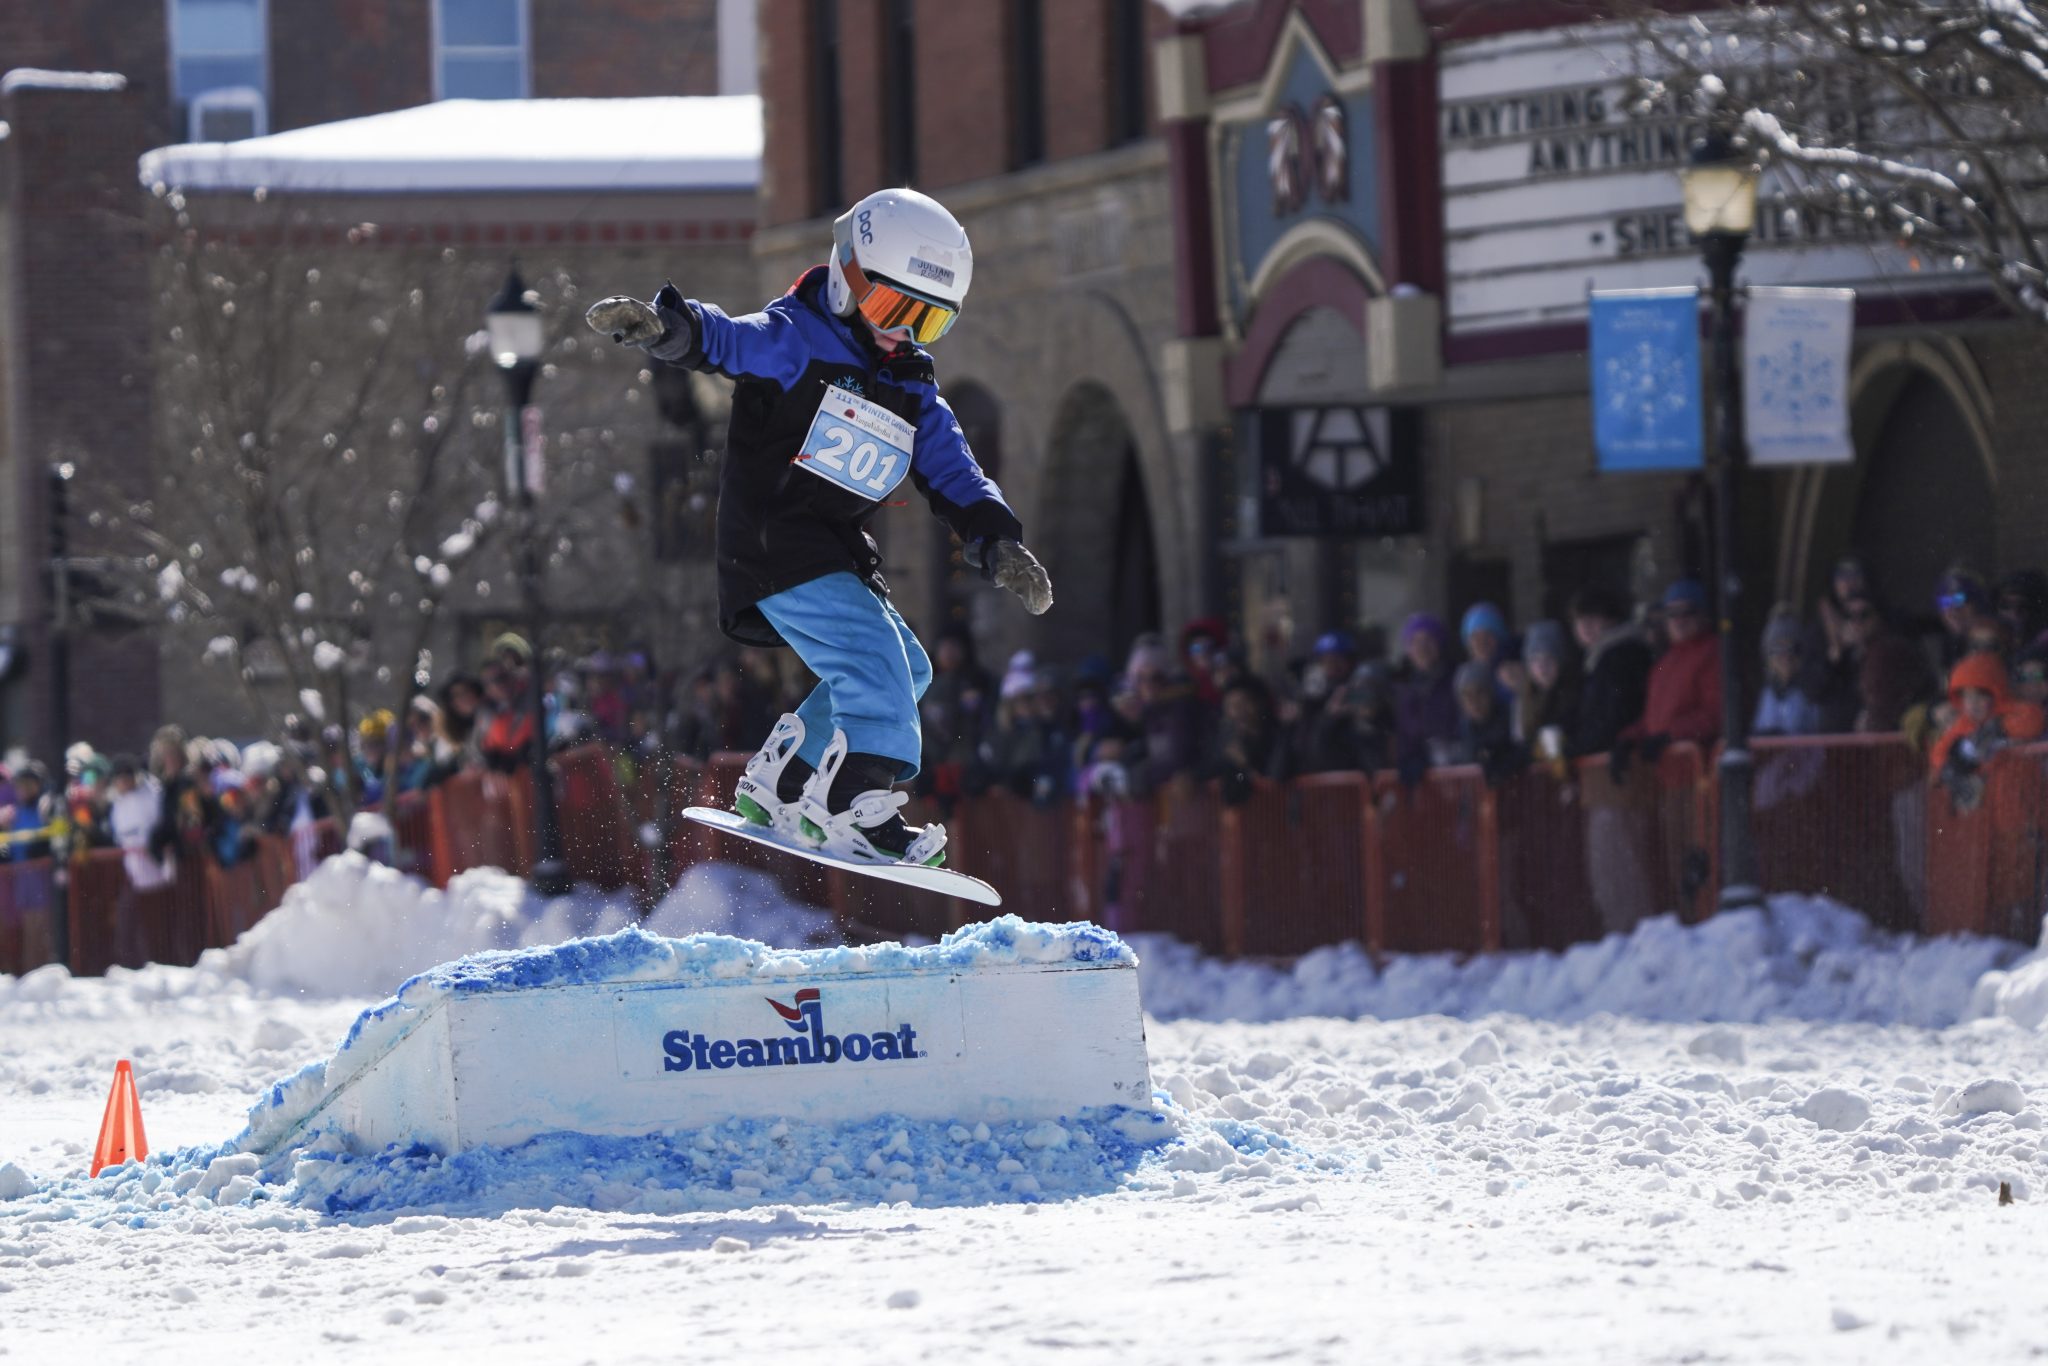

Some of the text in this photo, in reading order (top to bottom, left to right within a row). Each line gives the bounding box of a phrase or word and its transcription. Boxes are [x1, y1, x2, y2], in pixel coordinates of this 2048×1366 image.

[1447, 86, 1605, 138] ANYTHING
[917, 260, 951, 279] JULIAN
[860, 402, 892, 424] WINTER
[814, 426, 898, 492] 201
[662, 999, 919, 1072] Steamboat
